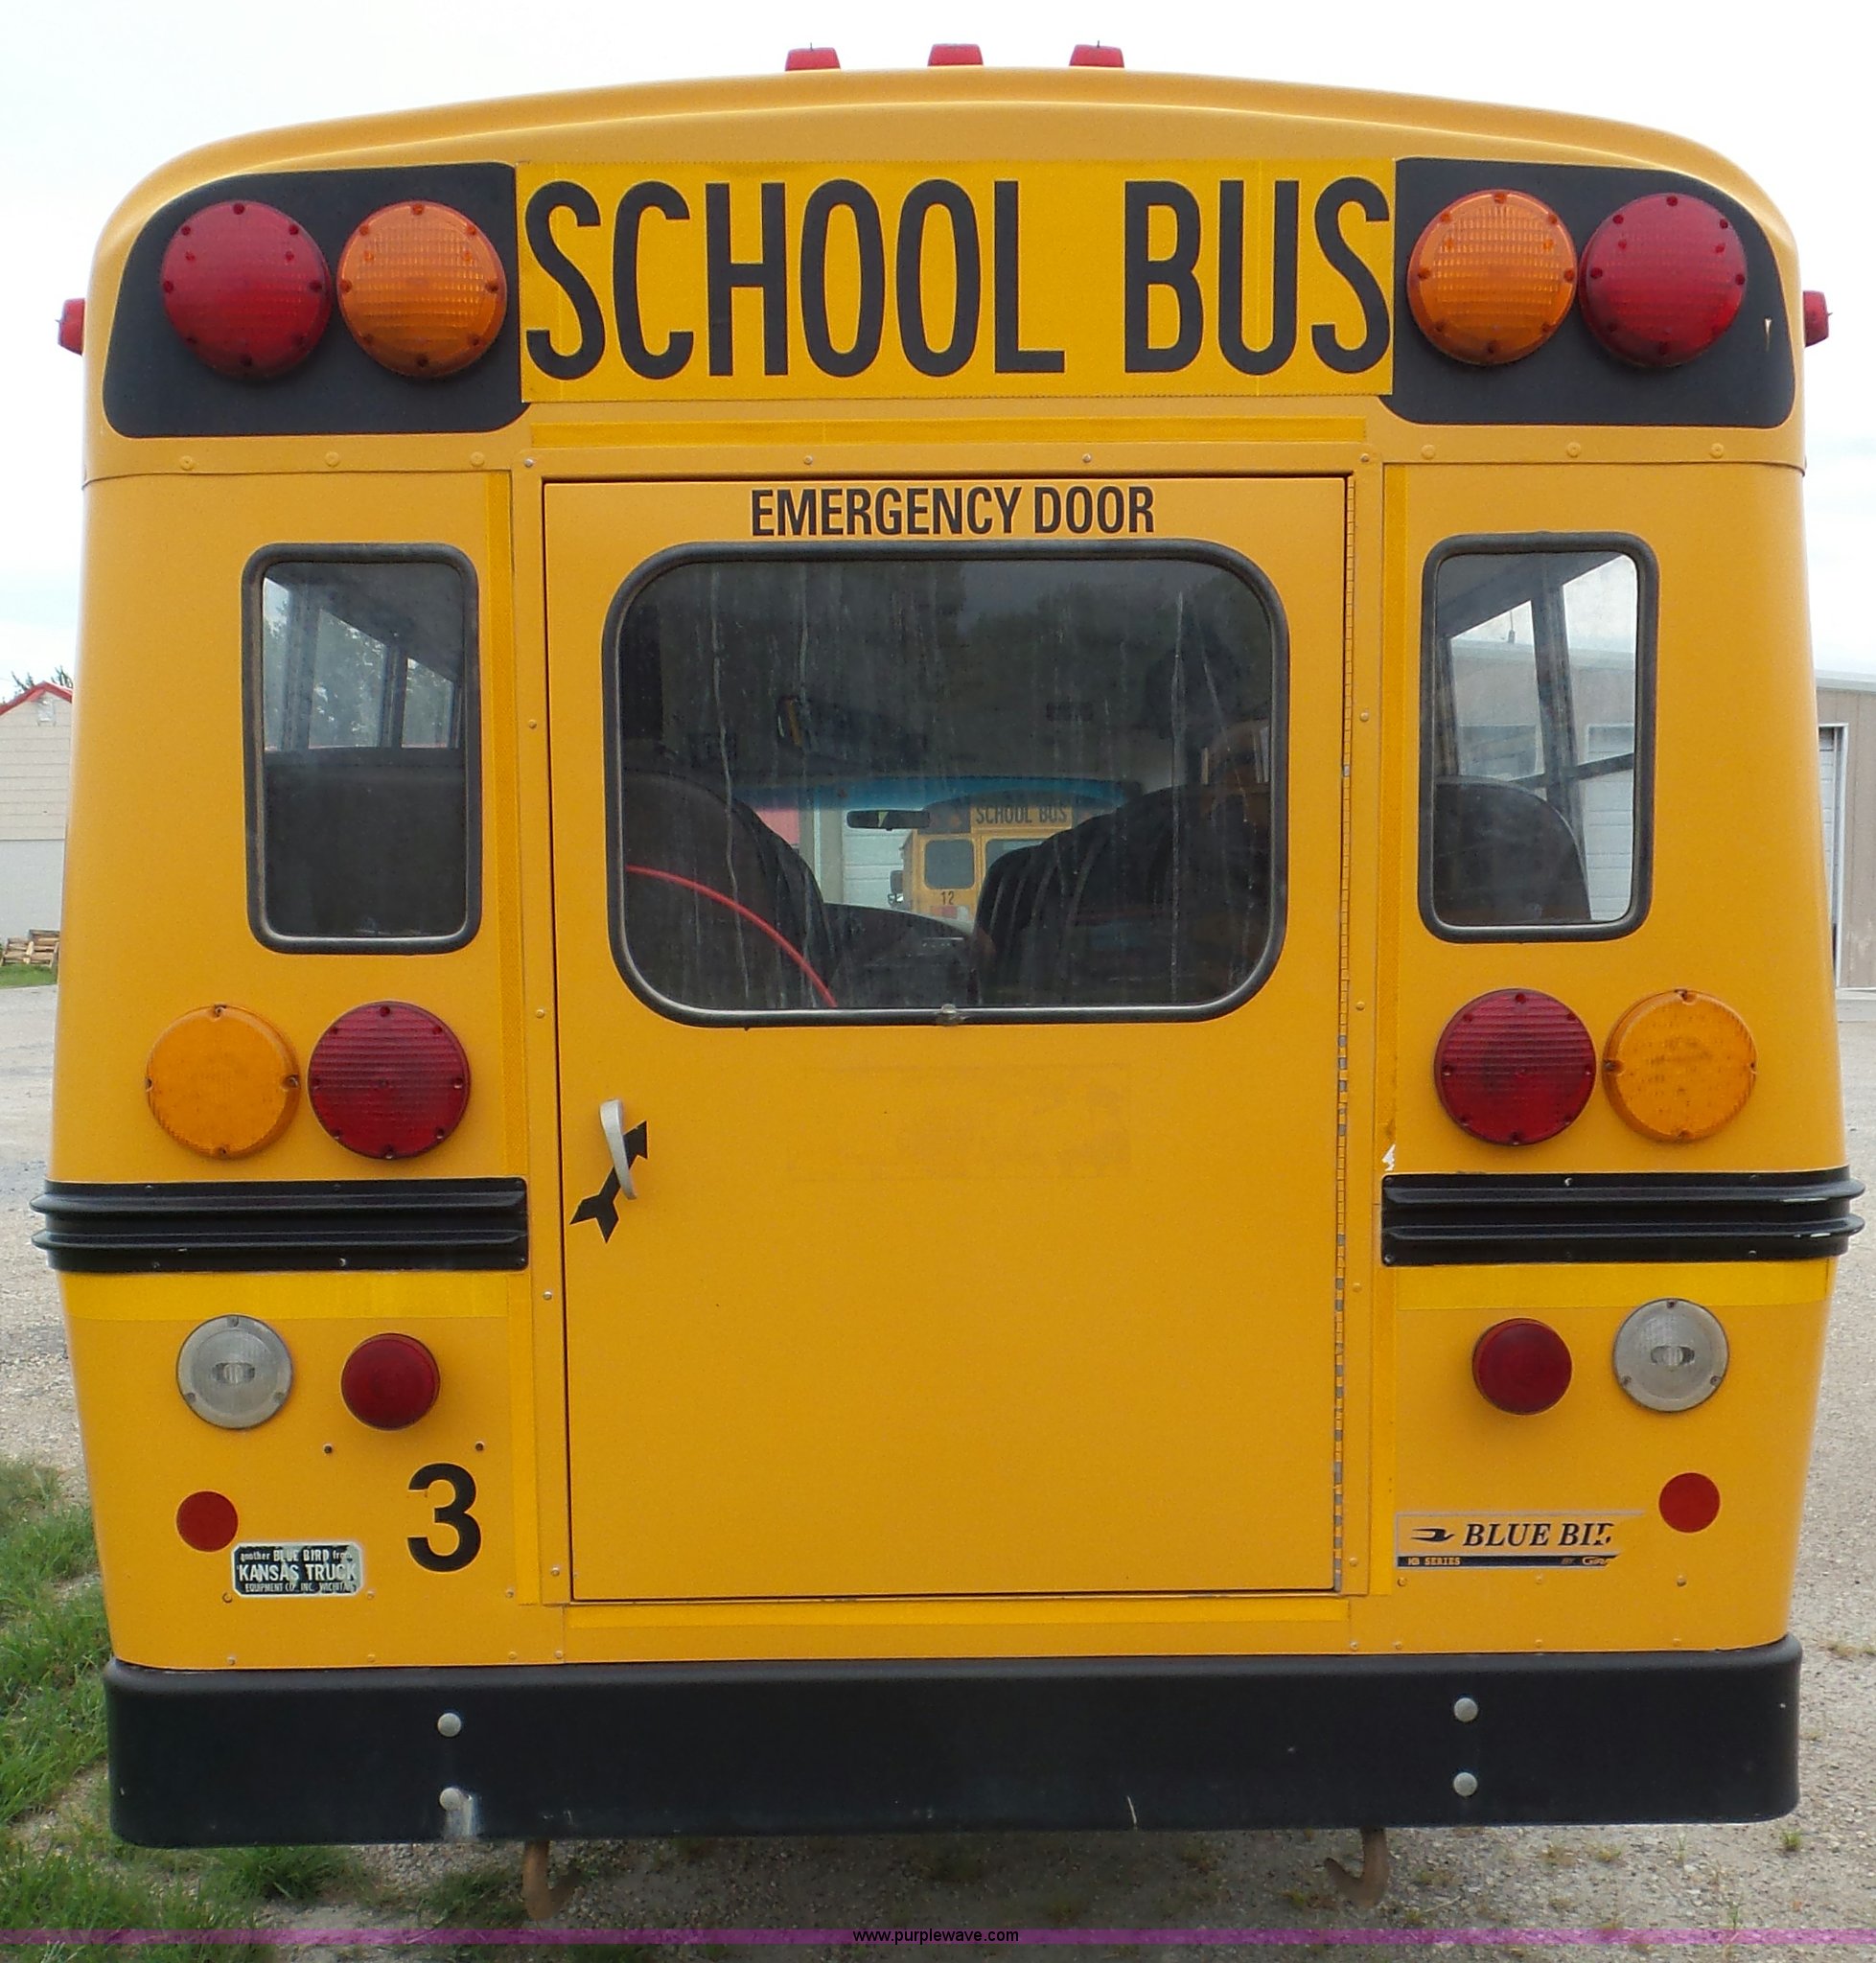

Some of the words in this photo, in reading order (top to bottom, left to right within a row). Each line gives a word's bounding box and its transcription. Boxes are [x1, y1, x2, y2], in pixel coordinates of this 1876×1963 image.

[524, 179, 1065, 380] SCHOOL
[1123, 176, 1392, 376] BUS
[751, 486, 1022, 537] EMERGENCY
[1033, 486, 1155, 535] DOOR
[975, 805, 1032, 824] SCHOOL
[1038, 806, 1068, 823] BUS
[939, 890, 955, 906] 12
[406, 1462, 482, 1573] 3
[1463, 1523, 1551, 1547] BLUE
[273, 1549, 299, 1562] BLUE
[303, 1549, 330, 1562] BIRD
[1424, 1557, 1461, 1566] SERIES
[239, 1563, 299, 1582] KANSAS
[305, 1563, 357, 1582] TRUCK
